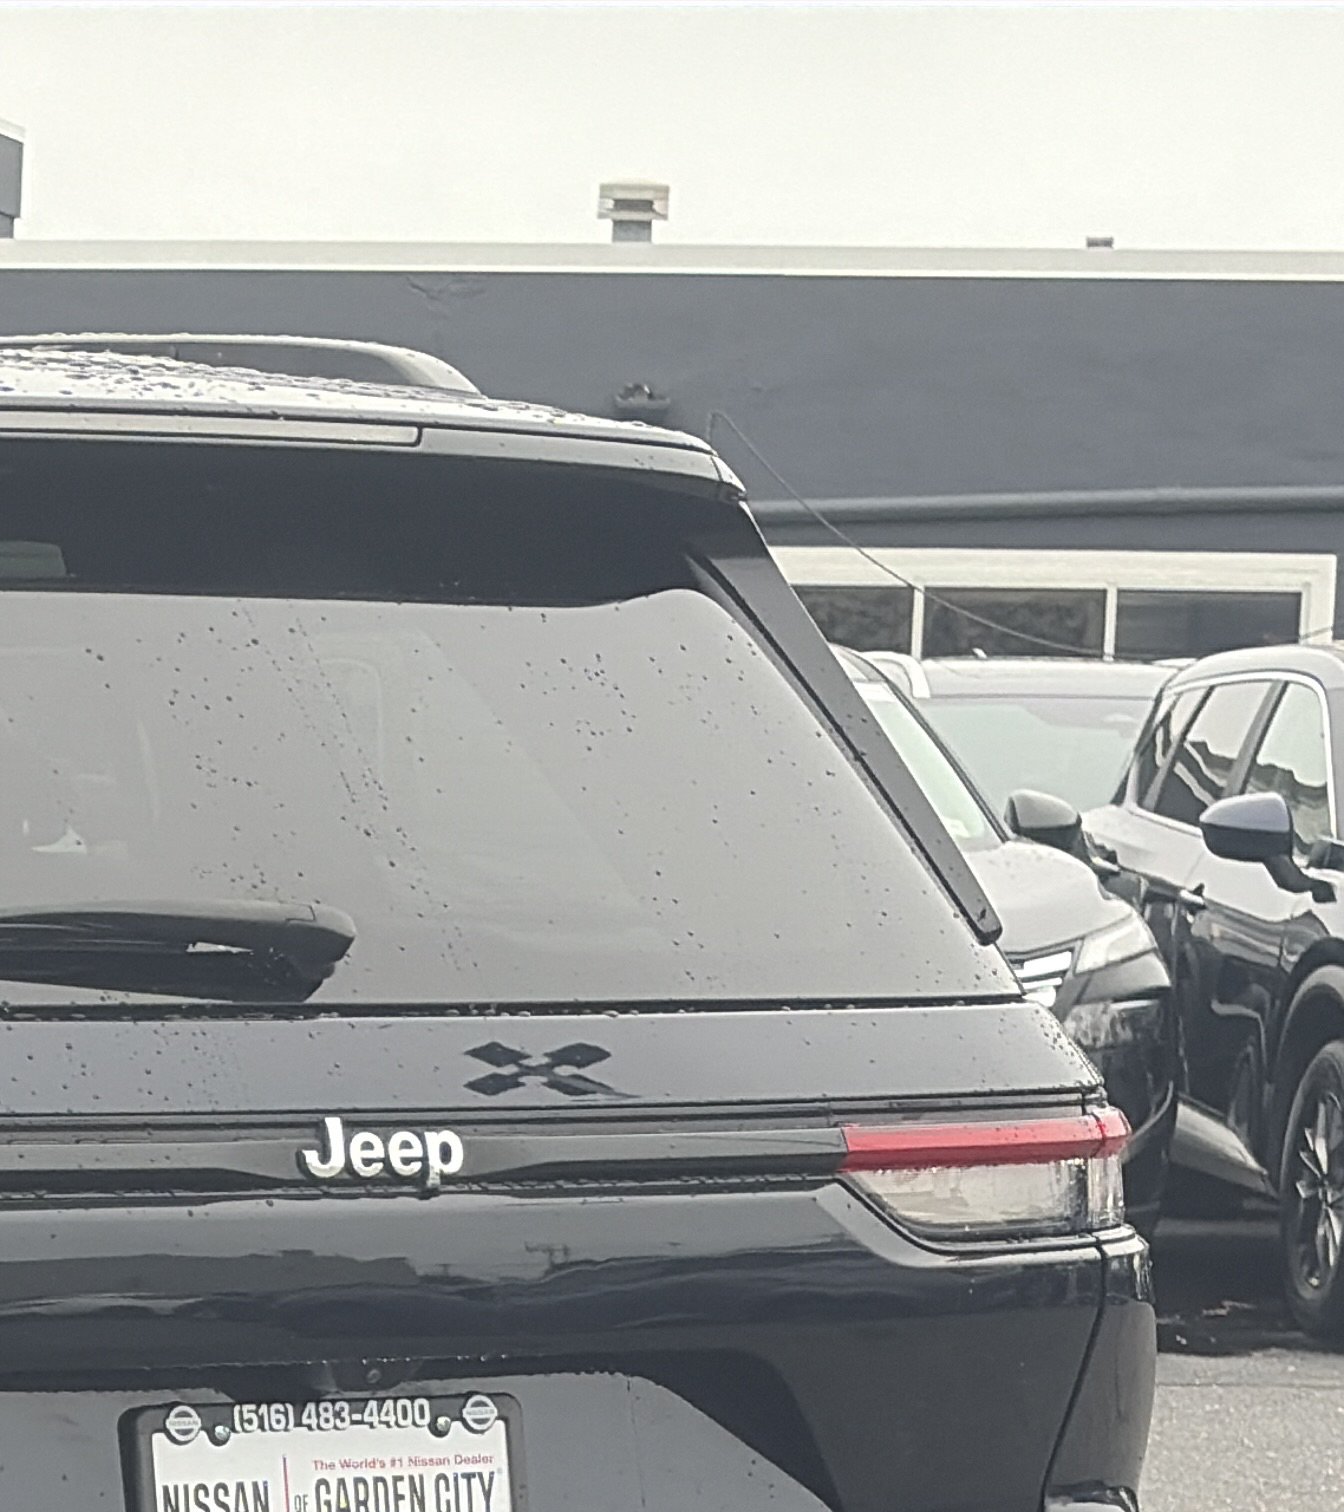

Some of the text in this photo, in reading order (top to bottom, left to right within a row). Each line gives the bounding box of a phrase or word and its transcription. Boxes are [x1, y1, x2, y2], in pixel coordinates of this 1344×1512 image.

[302, 1117, 464, 1187] Jeep
[233, 1398, 430, 1432] (516) 483-4400
[313, 1453, 494, 1471] The World's #1 Nissan Dealer
